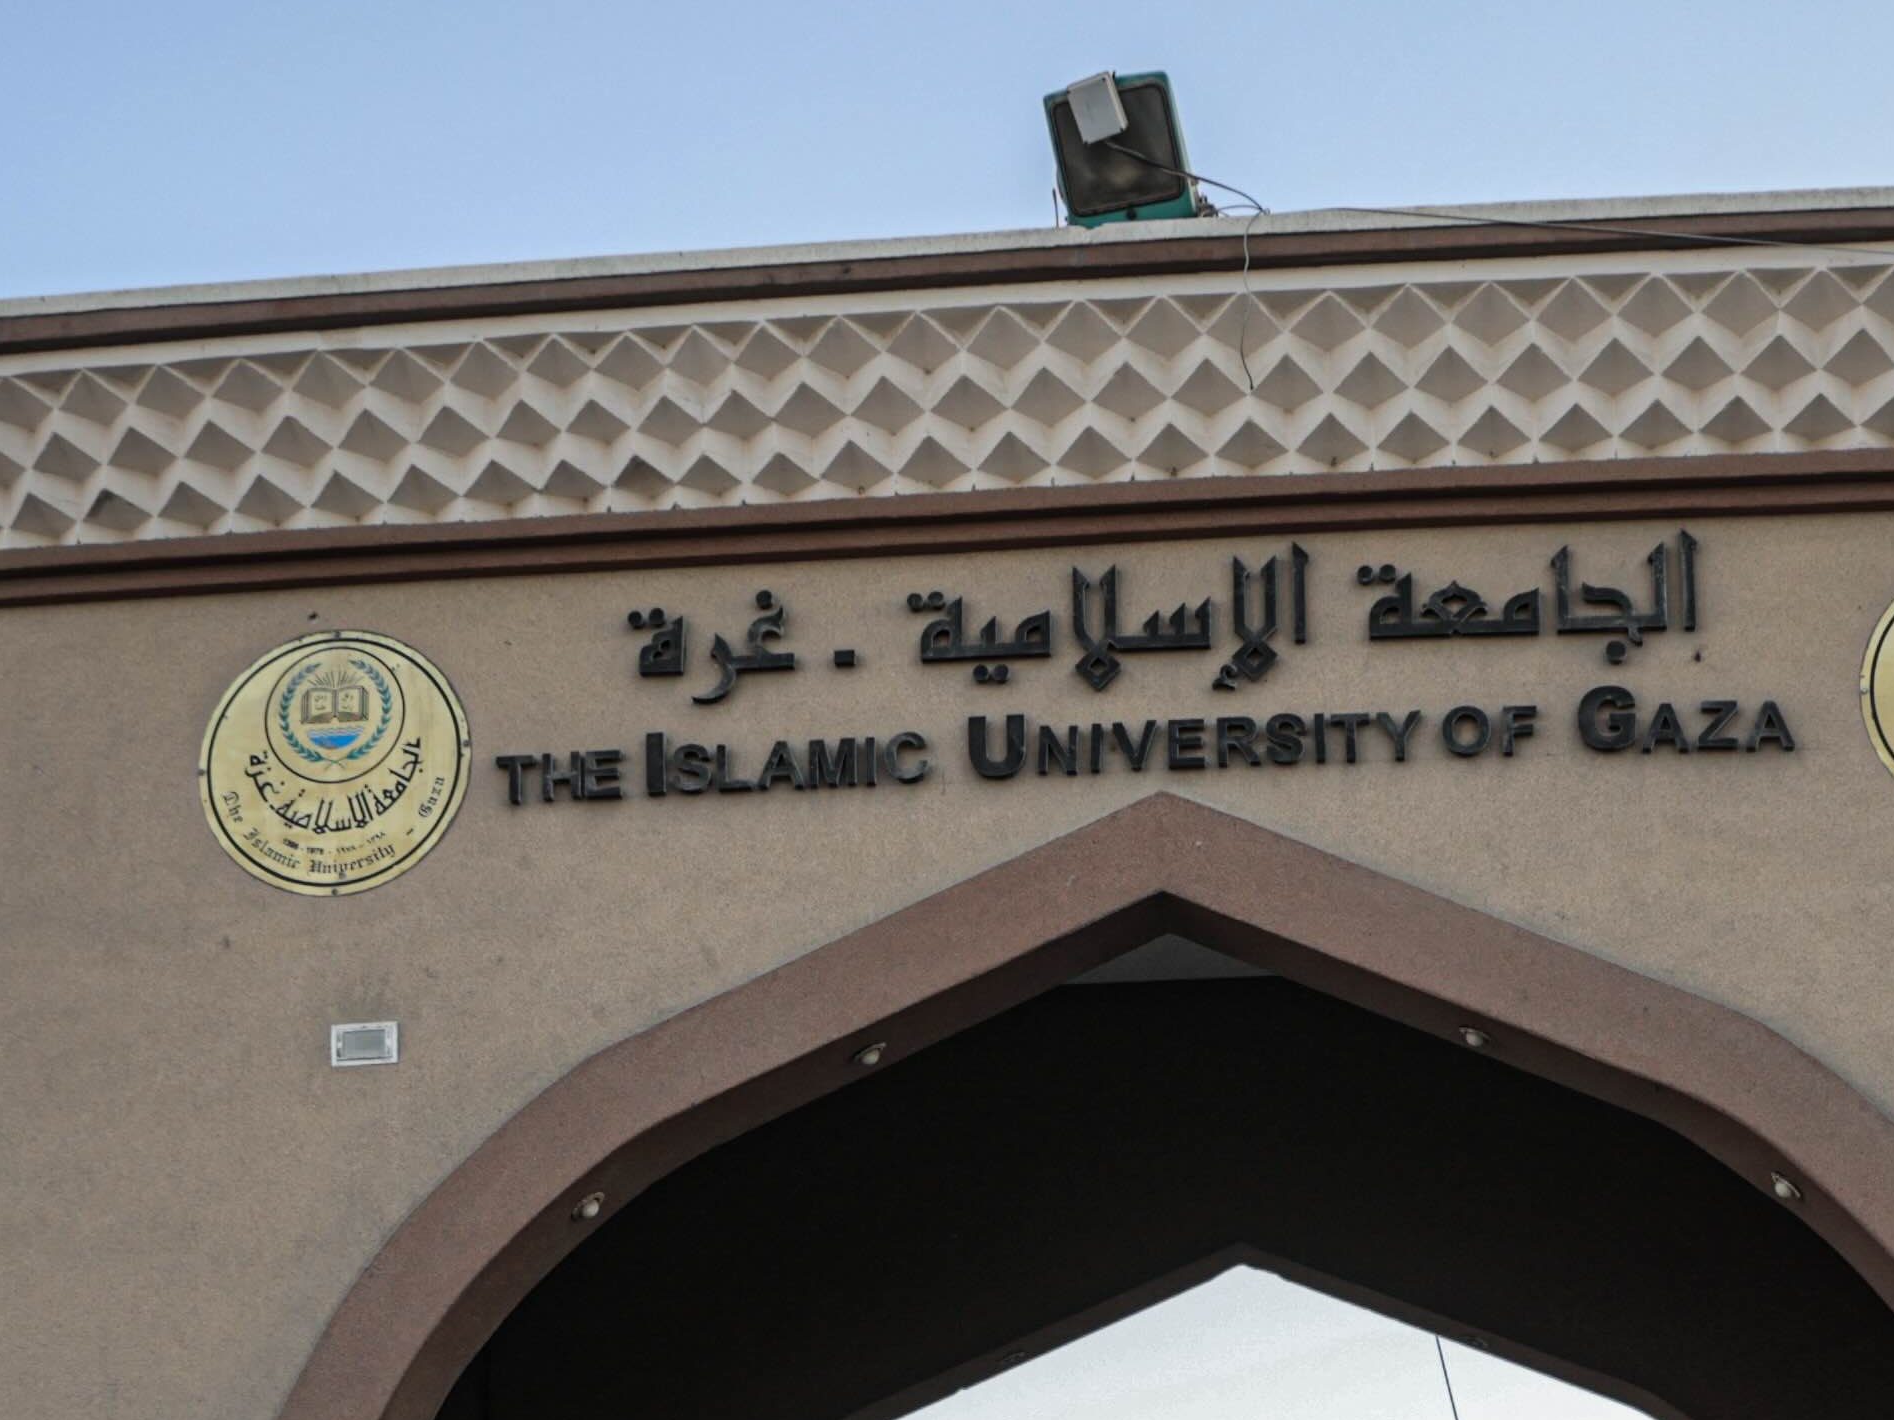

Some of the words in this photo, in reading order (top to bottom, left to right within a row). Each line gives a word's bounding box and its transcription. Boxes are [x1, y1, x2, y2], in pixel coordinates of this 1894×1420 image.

[907, 541, 1310, 692] الإسلامية
[1356, 528, 1698, 665] الجامعة
[244, 750, 285, 803] غزة
[364, 737, 423, 816] الجامعة
[496, 748, 623, 804] THE
[645, 731, 929, 796] ISLAMIC
[967, 709, 1422, 780] UNIVERSITY
[1441, 705, 1538, 758] OF
[1577, 685, 1796, 755] GAZA
[222, 791, 244, 823] The
[242, 827, 300, 869] Islamic
[308, 844, 396, 876] University
[418, 776, 446, 818] Gaza
